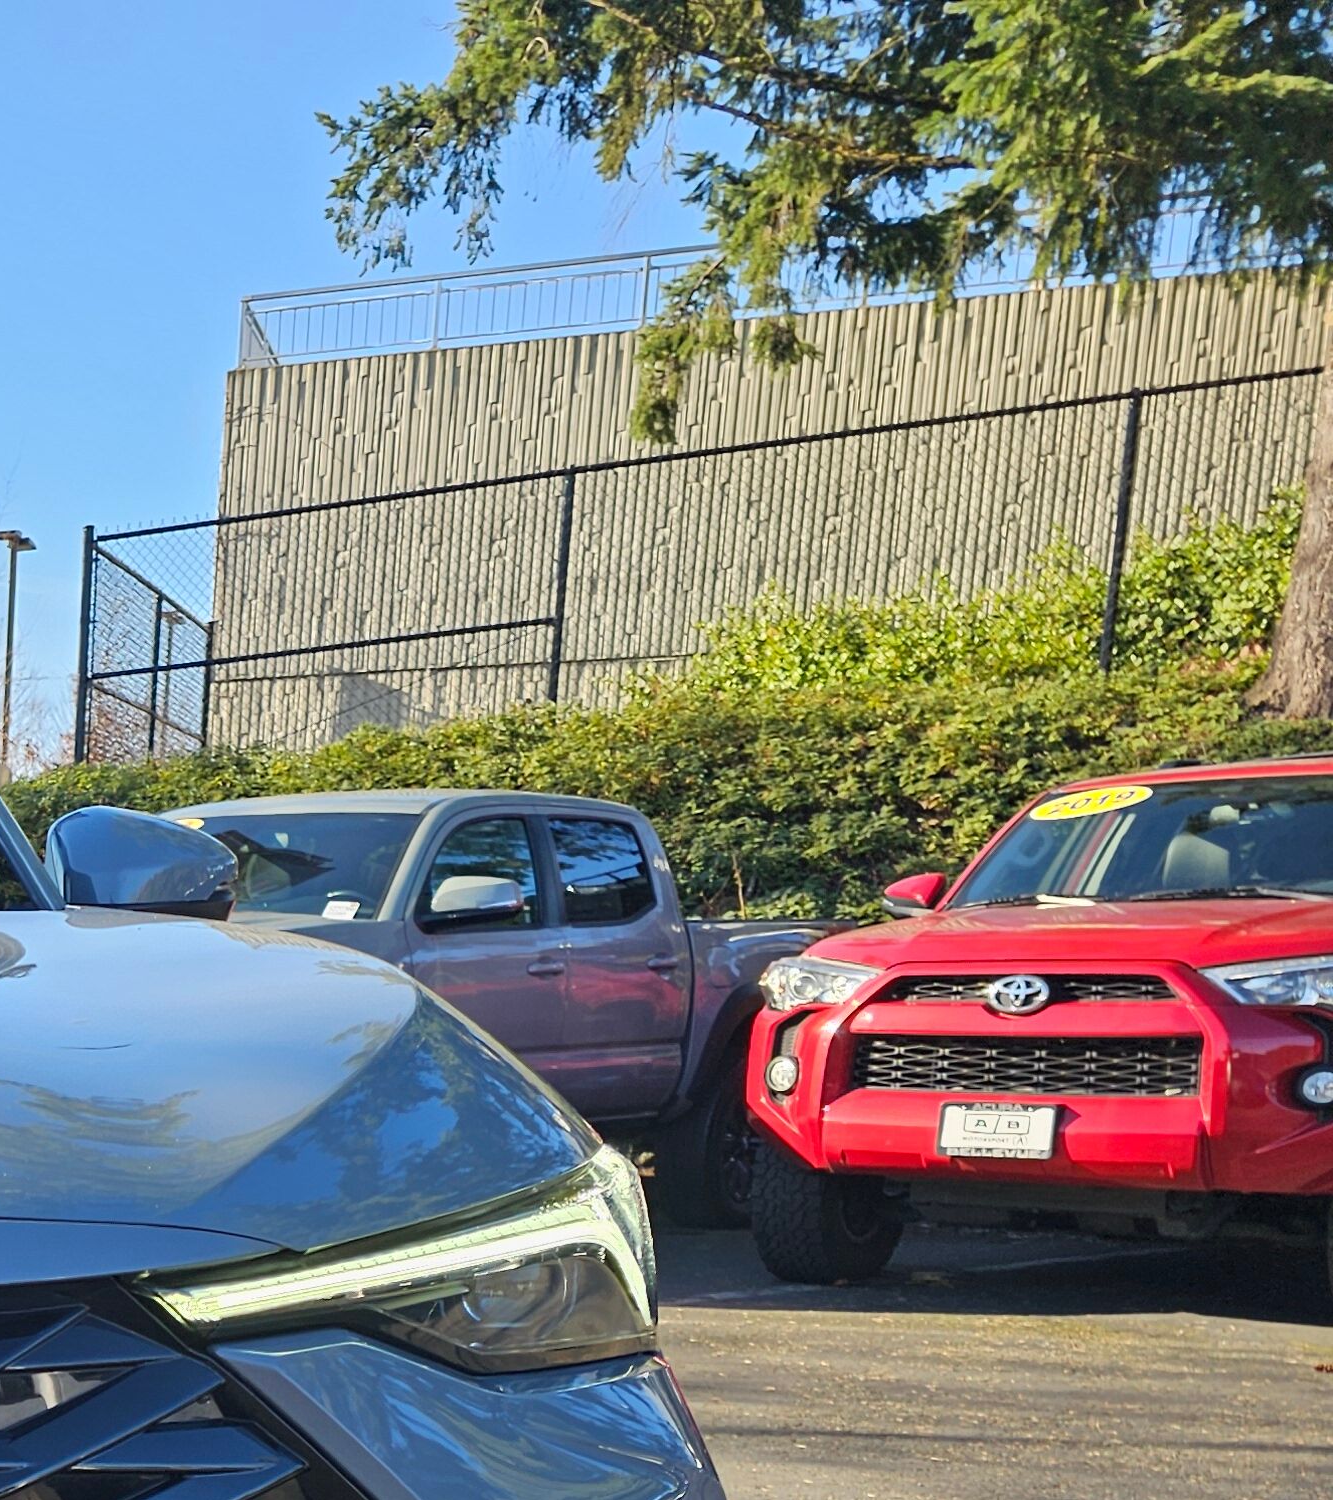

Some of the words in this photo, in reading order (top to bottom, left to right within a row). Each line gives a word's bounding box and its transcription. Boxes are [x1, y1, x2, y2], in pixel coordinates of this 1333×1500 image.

[1046, 791, 1135, 815] 2019
[972, 1103, 1024, 1112] ACURA
[974, 1119, 987, 1128] A
